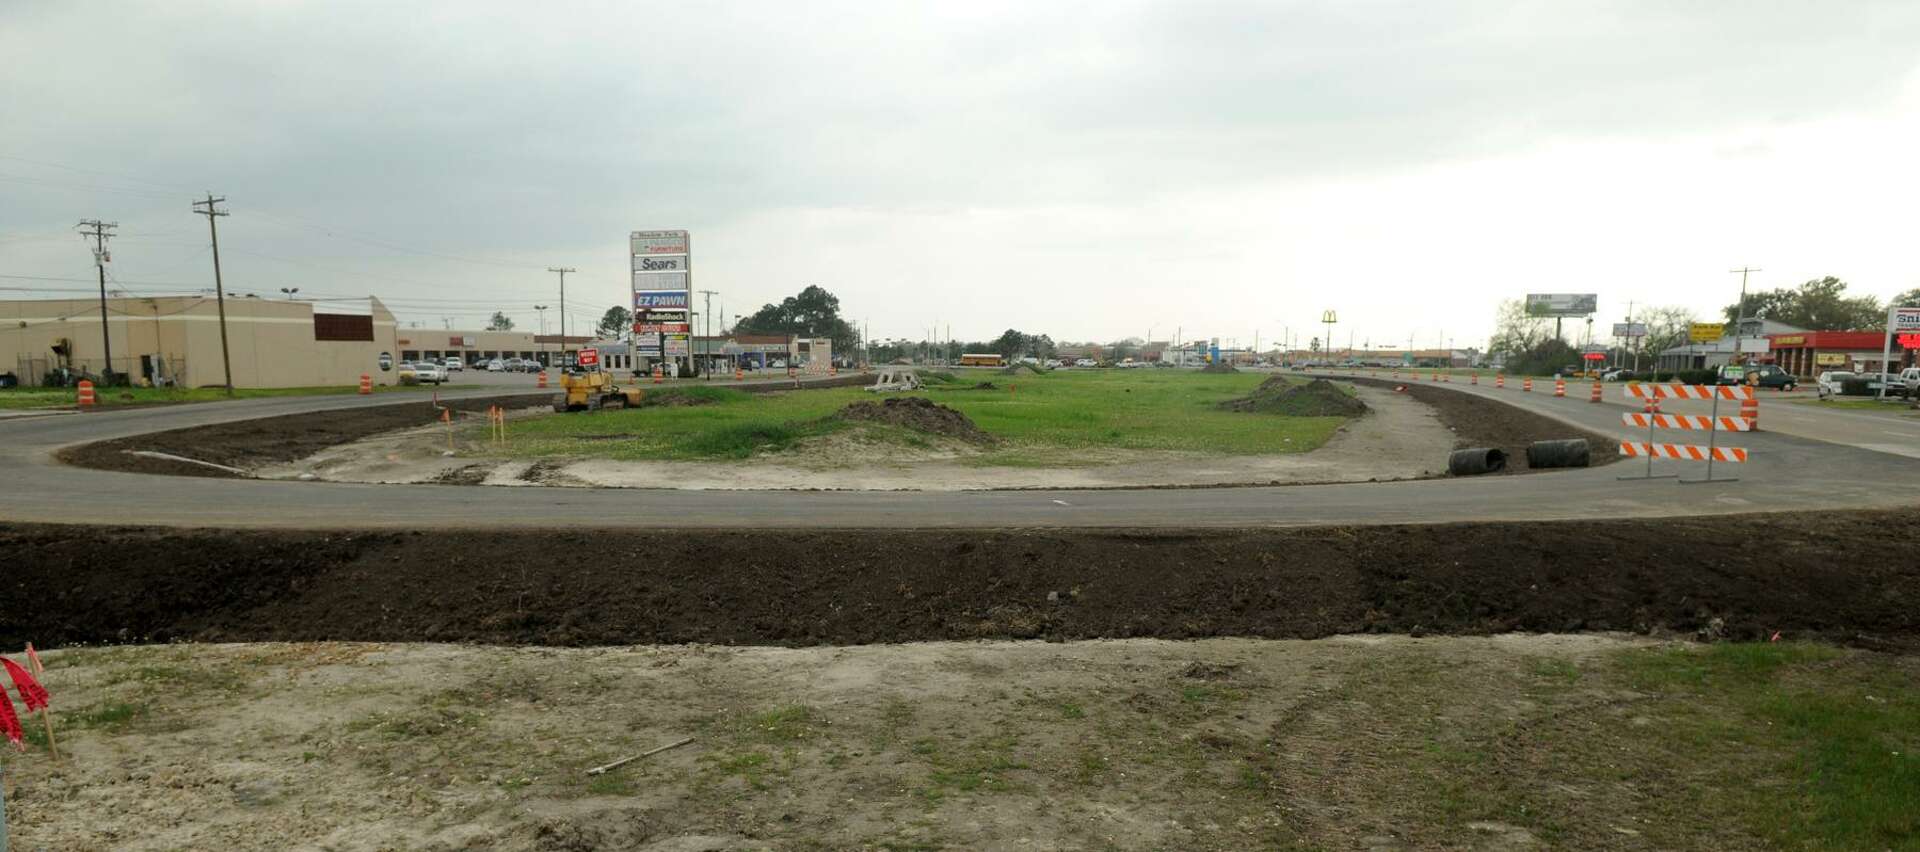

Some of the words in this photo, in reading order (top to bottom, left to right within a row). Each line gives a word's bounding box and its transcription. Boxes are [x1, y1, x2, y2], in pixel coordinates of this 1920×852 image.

[642, 258, 677, 271] Sears
[638, 295, 651, 306] EZ
[652, 295, 685, 306] PAWN
[646, 313, 684, 321] RadioShack
